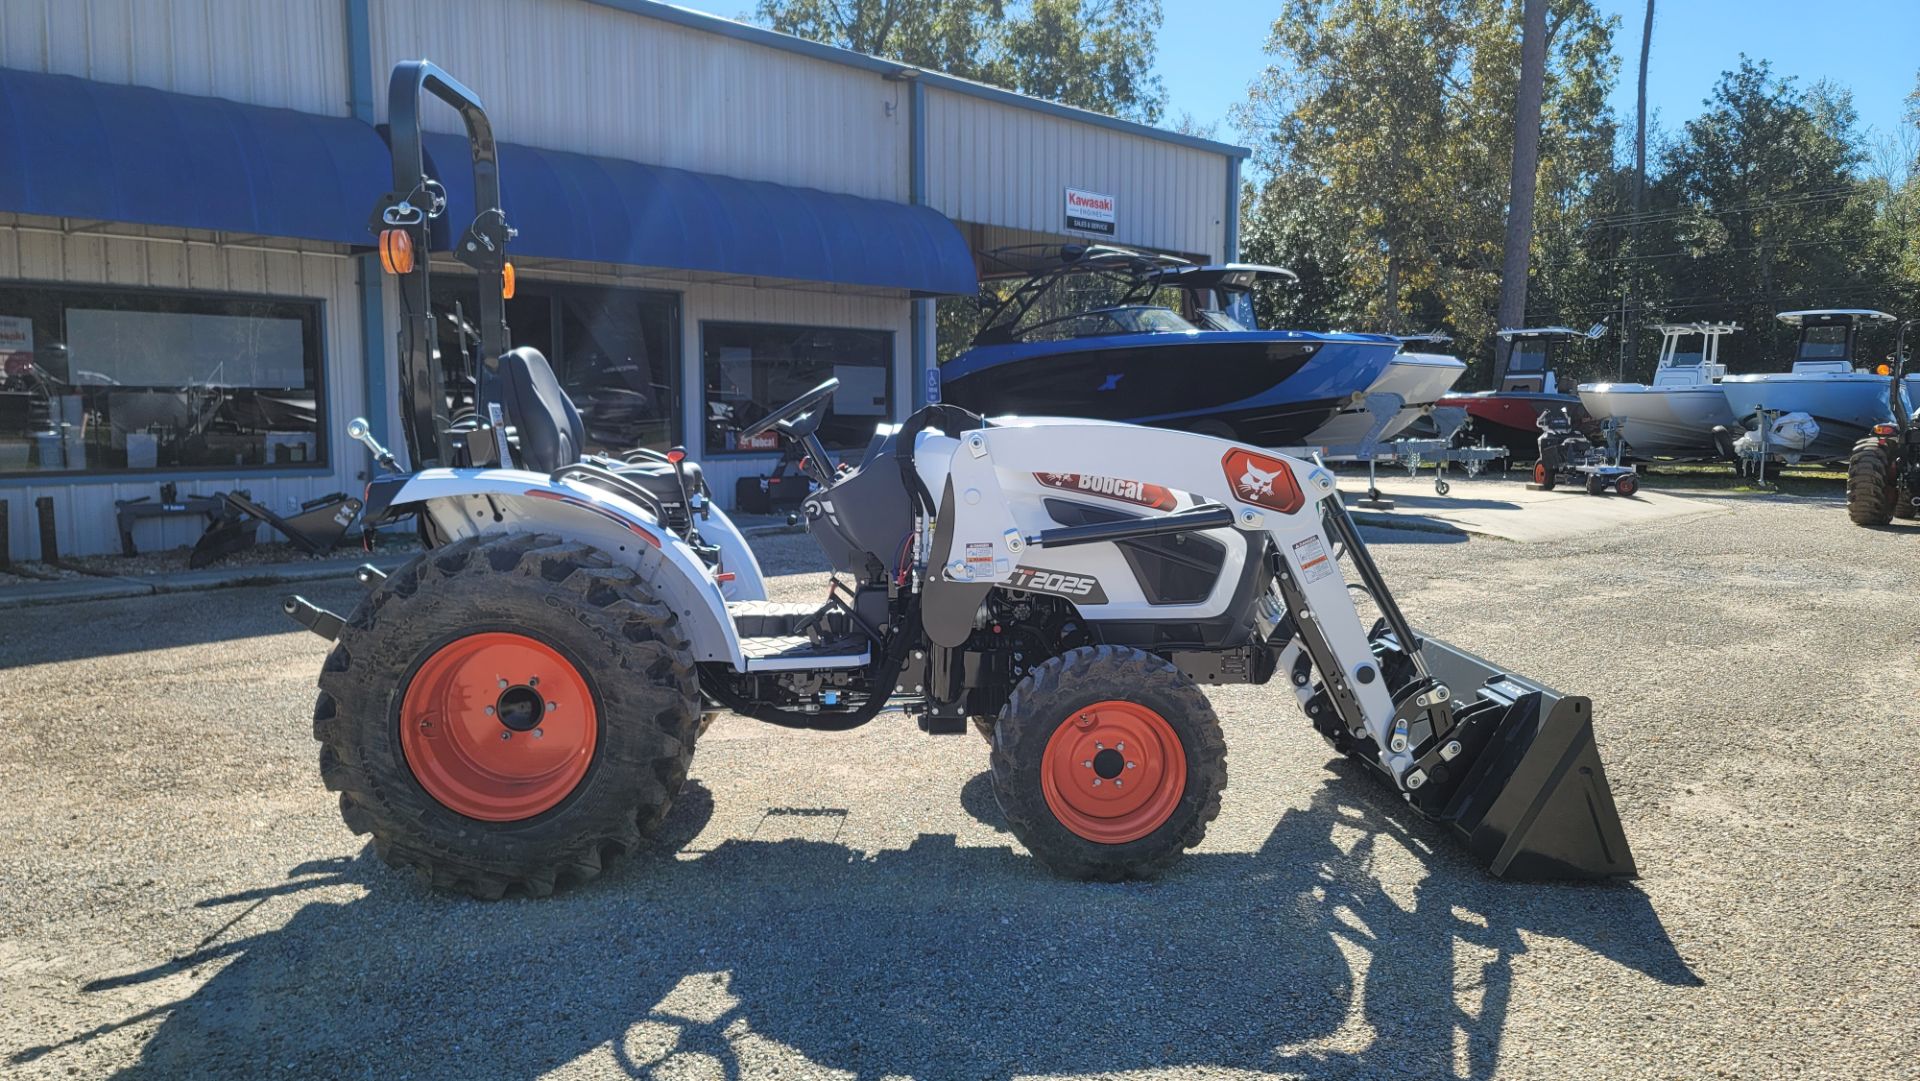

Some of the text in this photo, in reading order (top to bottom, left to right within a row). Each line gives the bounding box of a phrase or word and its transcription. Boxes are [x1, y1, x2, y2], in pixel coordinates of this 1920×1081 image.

[1069, 192, 1112, 211] Kawasaki
[752, 437, 775, 448] Bobcat
[1078, 475, 1143, 500] Bobcat
